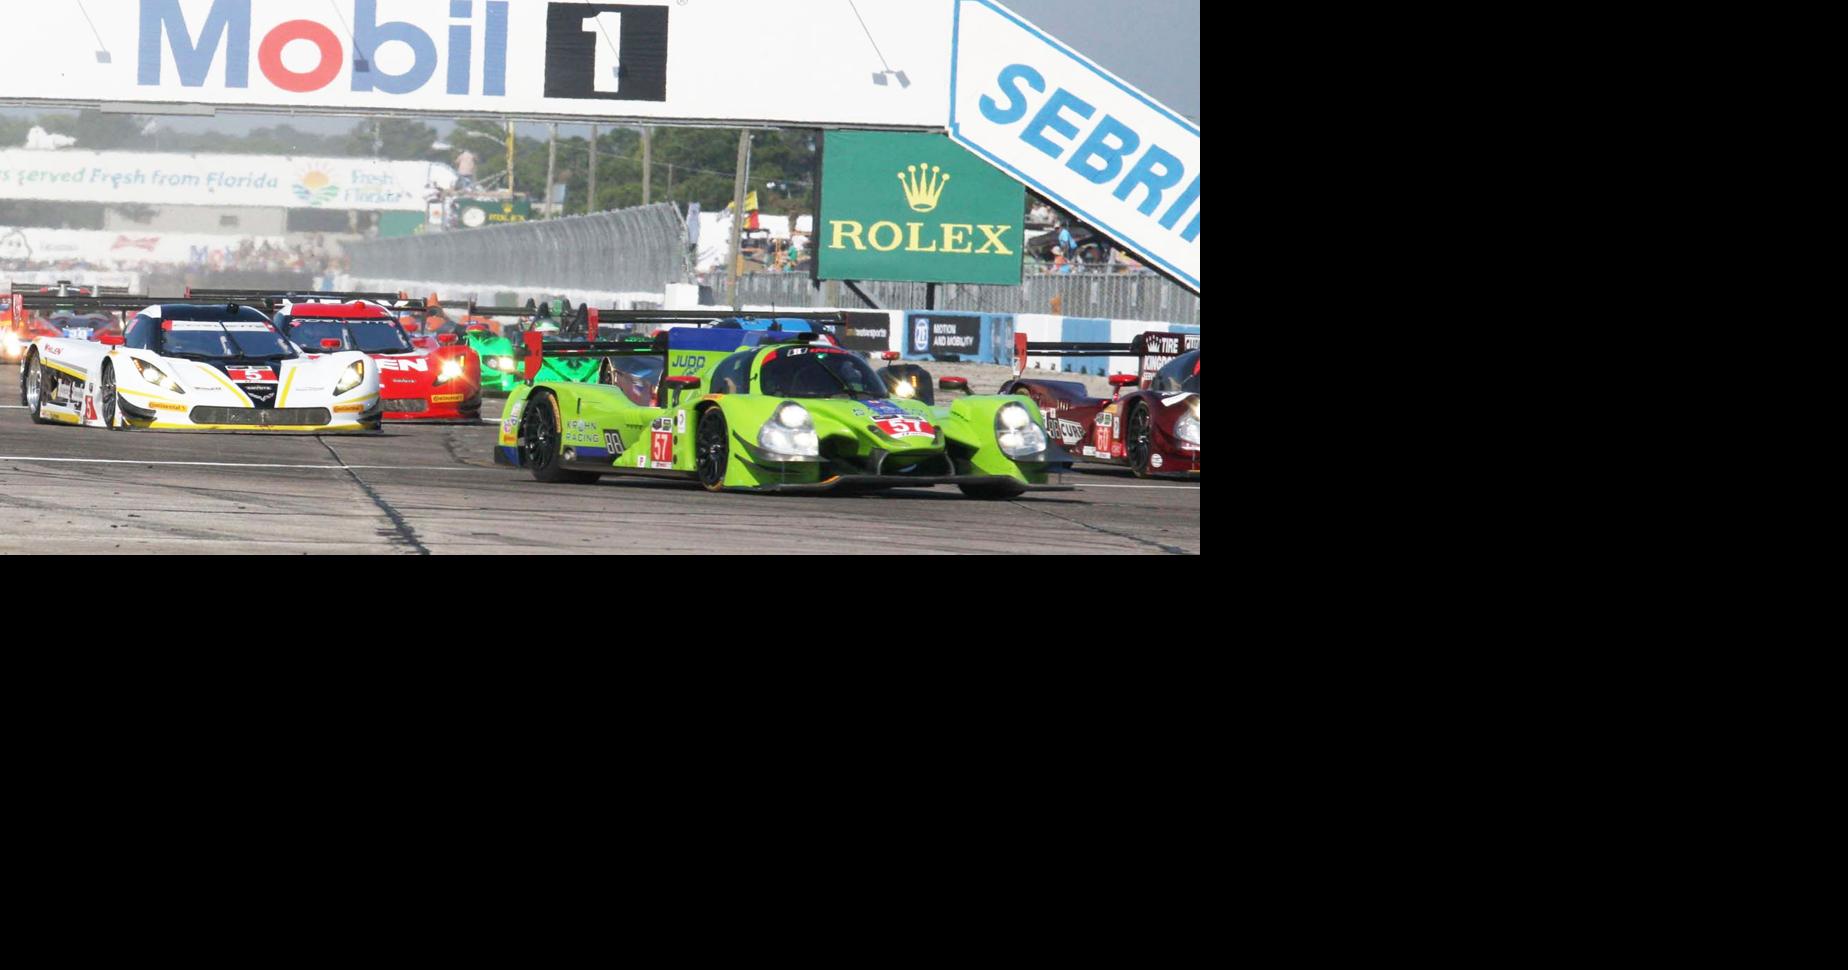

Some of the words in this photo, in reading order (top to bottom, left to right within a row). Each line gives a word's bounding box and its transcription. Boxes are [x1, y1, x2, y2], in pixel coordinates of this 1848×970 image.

[137, 0, 509, 95] Mobil
[582, 12, 621, 93] 1
[18, 168, 85, 184] served
[90, 168, 145, 186] Fresh
[152, 170, 200, 186] from
[207, 172, 278, 188] Florida
[828, 220, 1013, 255] ROLEX
[933, 324, 957, 335] MOTION
[933, 336, 946, 346] AND
[947, 336, 974, 347] MOBILITY
[1161, 338, 1179, 353] TIRE
[672, 355, 705, 368] JUDD
[245, 368, 262, 381] 5
[888, 419, 922, 433] 57
[566, 433, 599, 443] RACING
[1097, 428, 1109, 450] 60
[654, 433, 668, 461] 57
